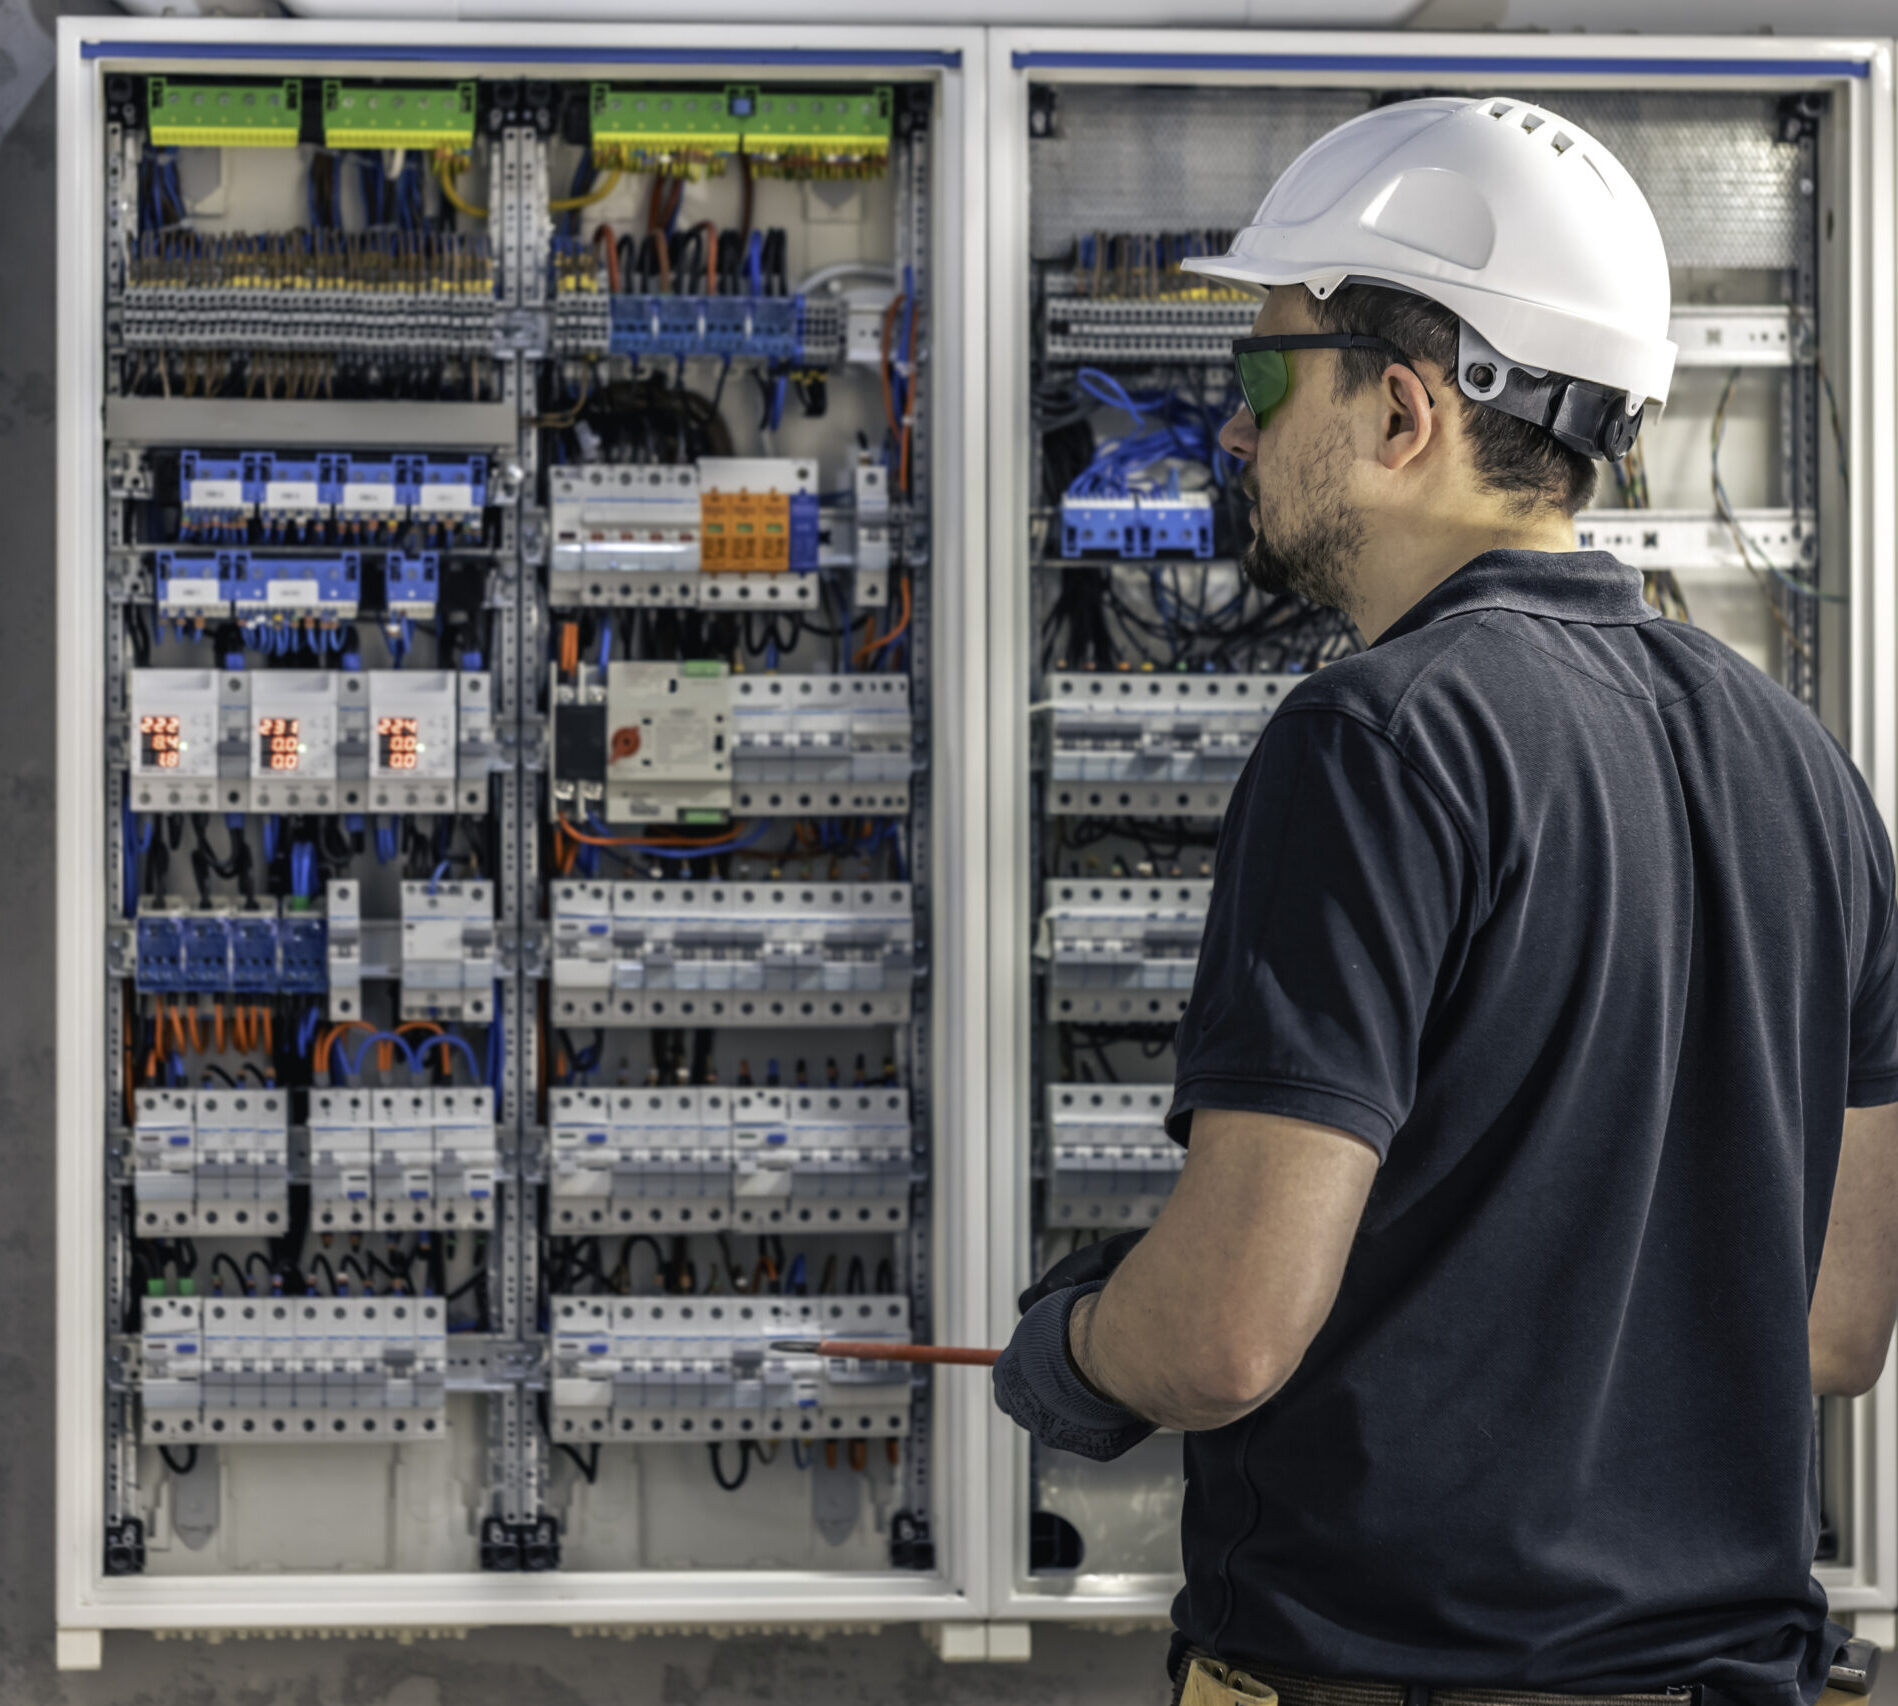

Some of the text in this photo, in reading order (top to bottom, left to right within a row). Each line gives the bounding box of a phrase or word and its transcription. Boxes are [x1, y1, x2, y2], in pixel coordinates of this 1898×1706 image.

[140, 716, 179, 733] 222
[260, 717, 299, 735] 231
[378, 717, 417, 734] 224
